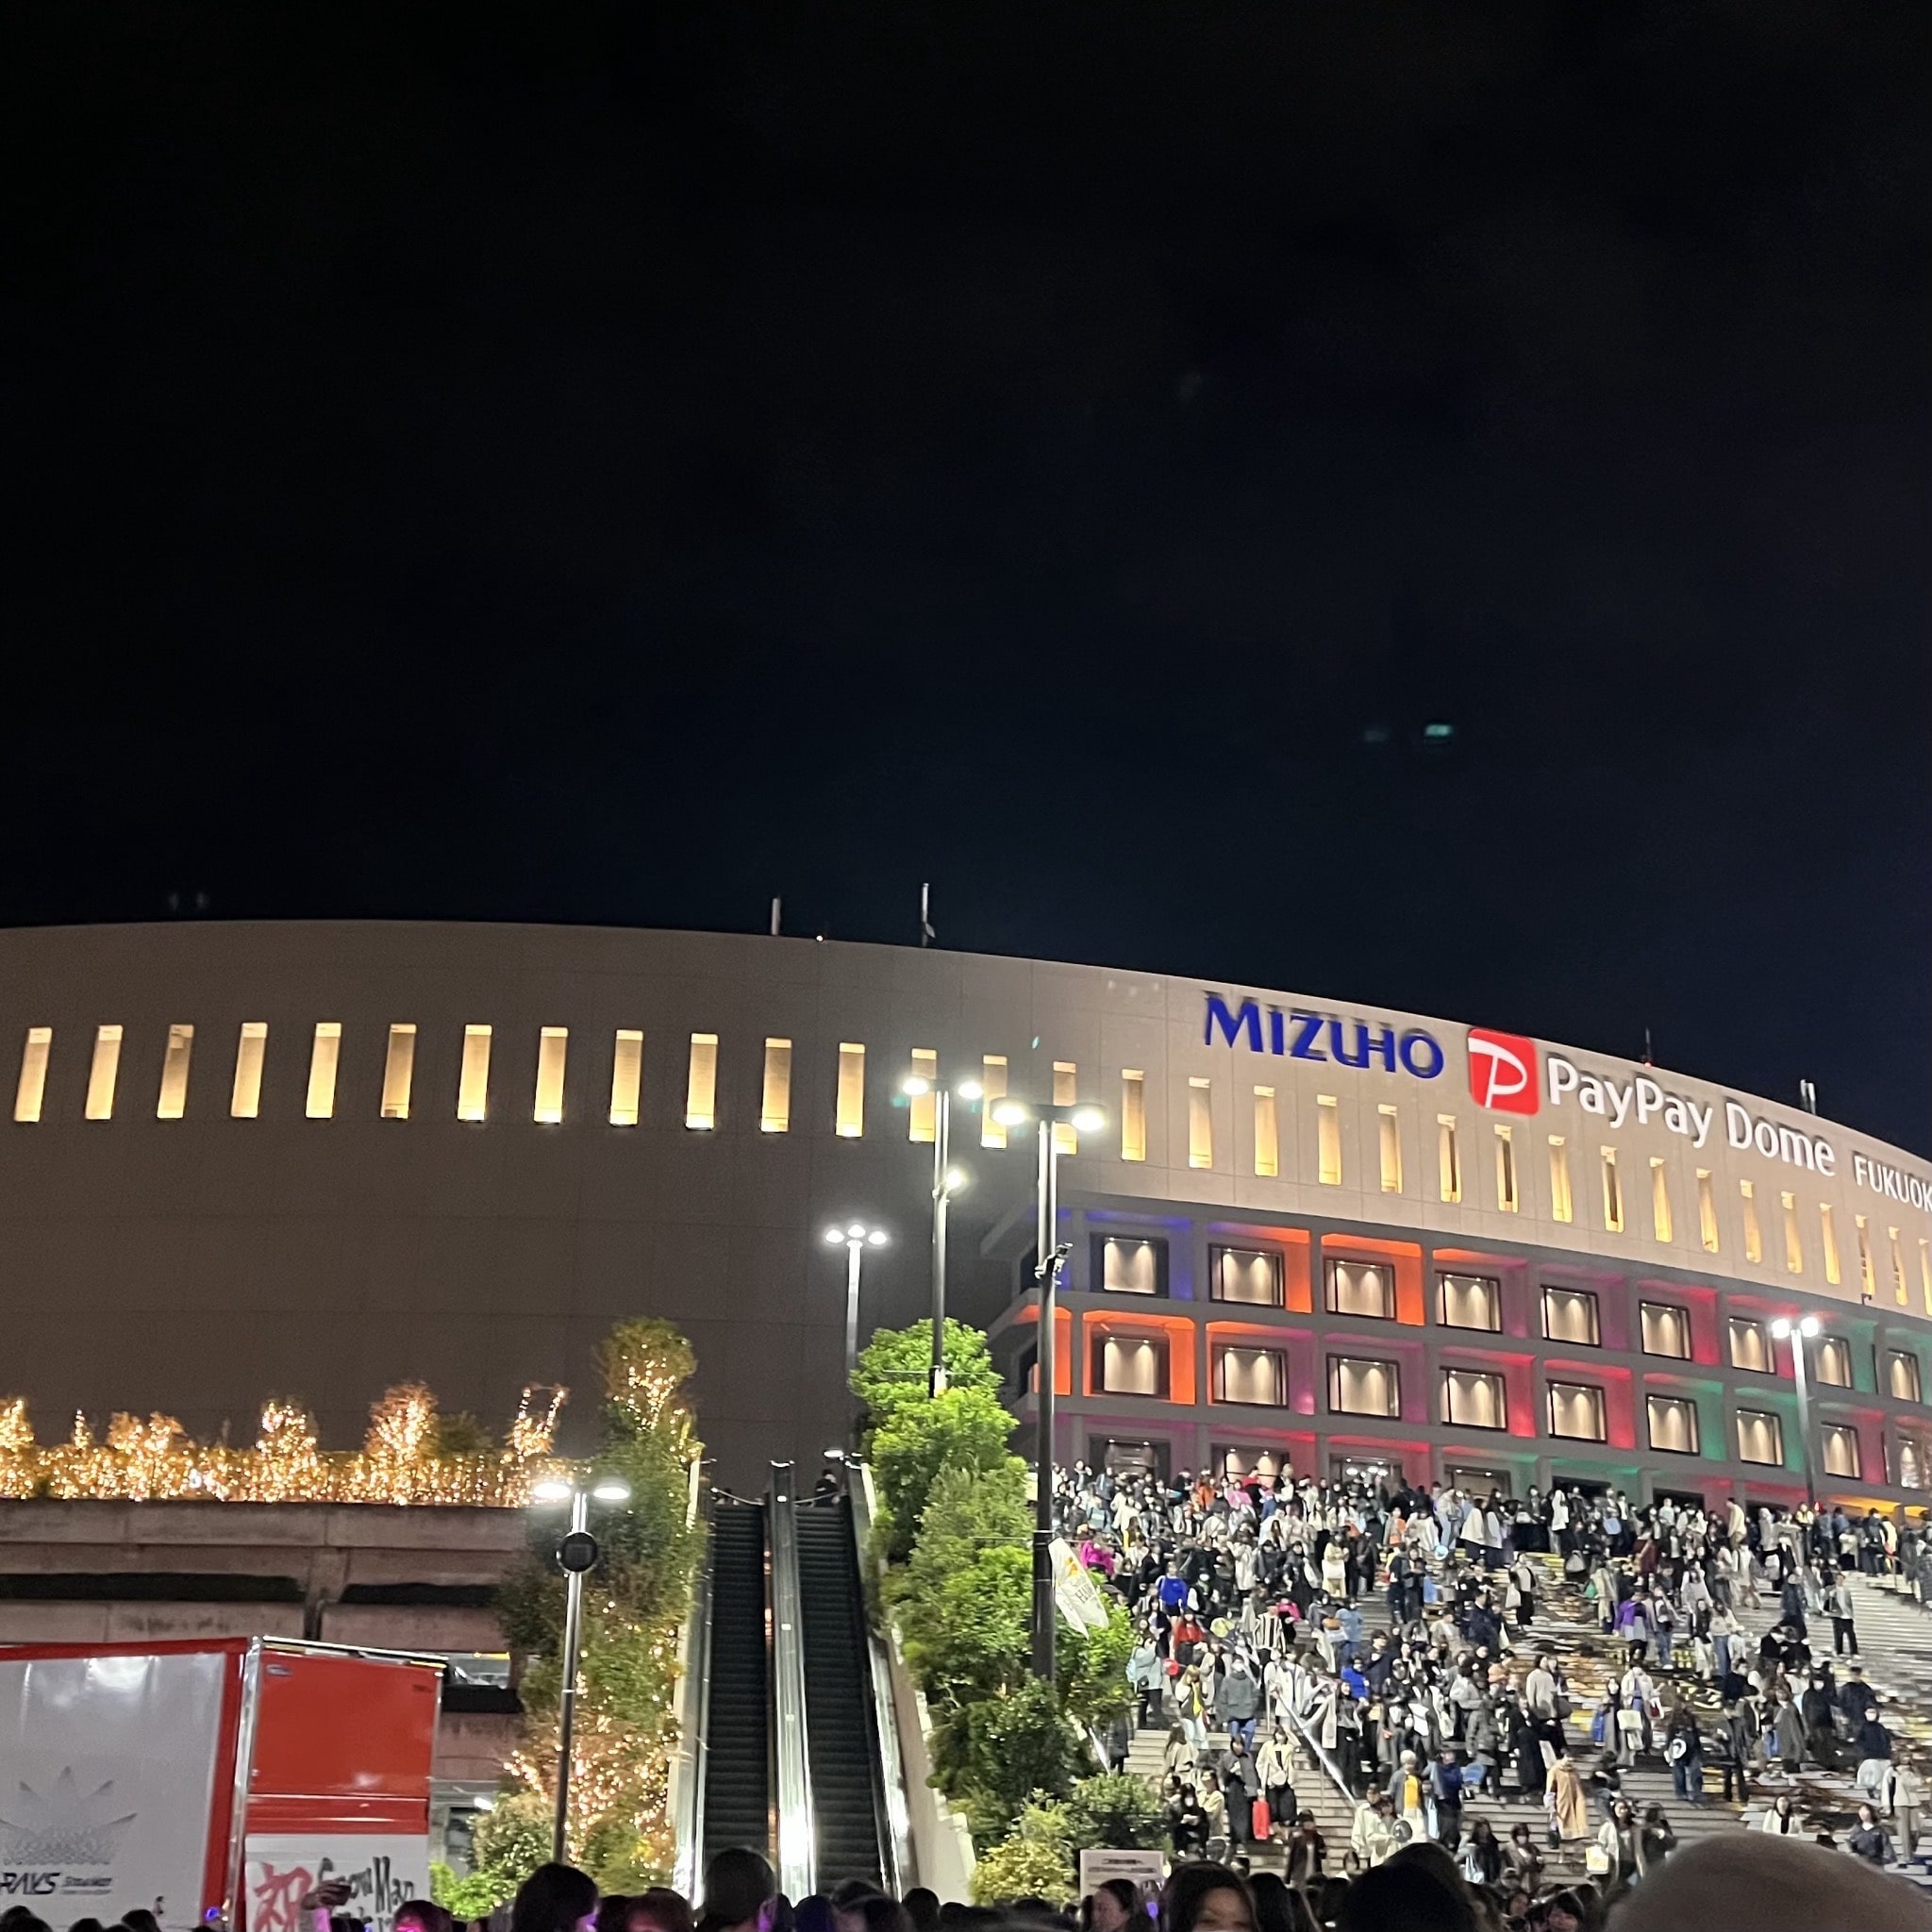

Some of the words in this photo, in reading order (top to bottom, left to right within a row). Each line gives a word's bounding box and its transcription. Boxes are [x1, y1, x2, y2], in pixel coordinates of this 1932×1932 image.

[1204, 992, 1444, 1079] MIZUHO
[1547, 1056, 1713, 1149] PayPay
[1725, 1100, 1836, 1177] Dome
